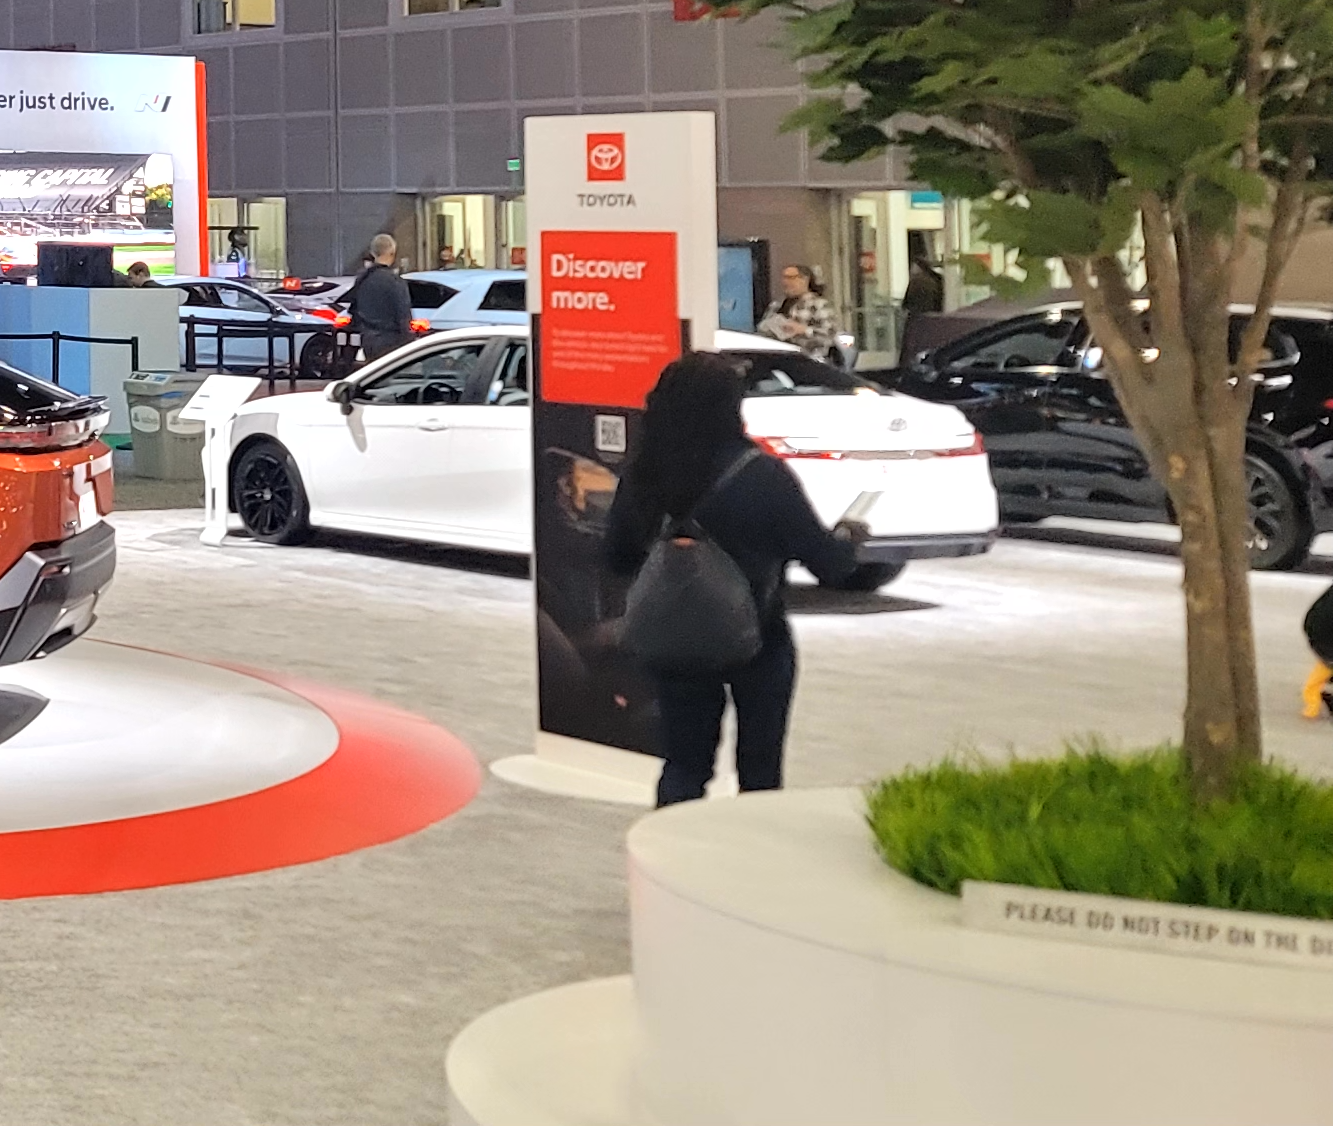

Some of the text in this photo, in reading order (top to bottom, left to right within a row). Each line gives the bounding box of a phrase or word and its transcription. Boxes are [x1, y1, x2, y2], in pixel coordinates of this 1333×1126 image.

[18, 90, 56, 113] just
[60, 91, 115, 112] drive.
[30, 167, 115, 188] CAPITAL
[577, 193, 637, 207] TOYOTA
[550, 253, 647, 280] Discover
[550, 290, 616, 312] more.
[1005, 900, 1078, 926] PLEASE
[1085, 908, 1116, 932] DO
[1121, 914, 1161, 937] NOT
[1167, 918, 1220, 943] STEP
[1225, 926, 1256, 948] ON
[1262, 929, 1299, 953] THE
